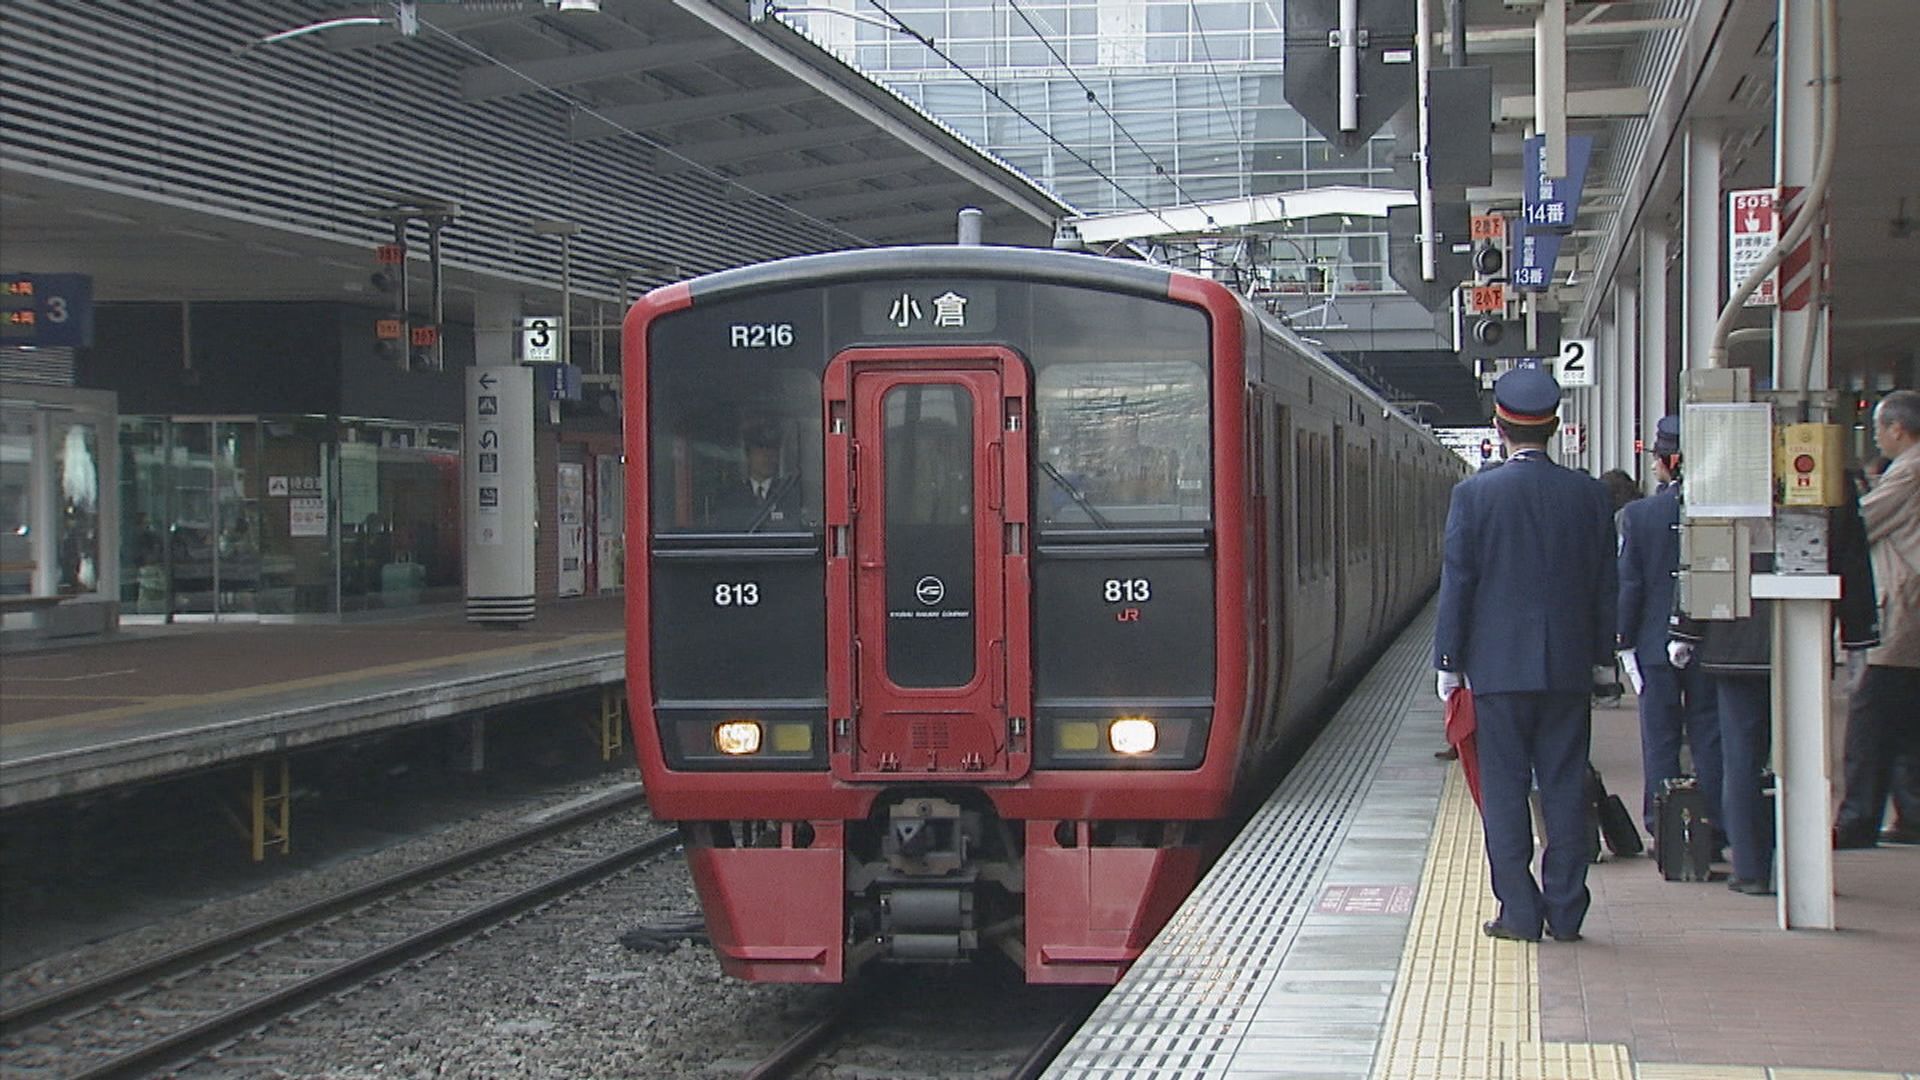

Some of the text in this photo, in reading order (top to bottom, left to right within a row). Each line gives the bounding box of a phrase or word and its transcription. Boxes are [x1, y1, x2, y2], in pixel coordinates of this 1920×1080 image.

[1527, 202, 1564, 223] 14番
[1737, 196, 1770, 209] SOS
[1514, 269, 1543, 284] 13番
[46, 296, 67, 323] 3
[889, 292, 967, 327] 小倉
[531, 320, 549, 347] 3
[731, 325, 793, 347] R216
[1564, 342, 1584, 371] 2
[715, 583, 759, 606] 813
[1105, 579, 1150, 602] 813
[1117, 608, 1139, 622] JR
